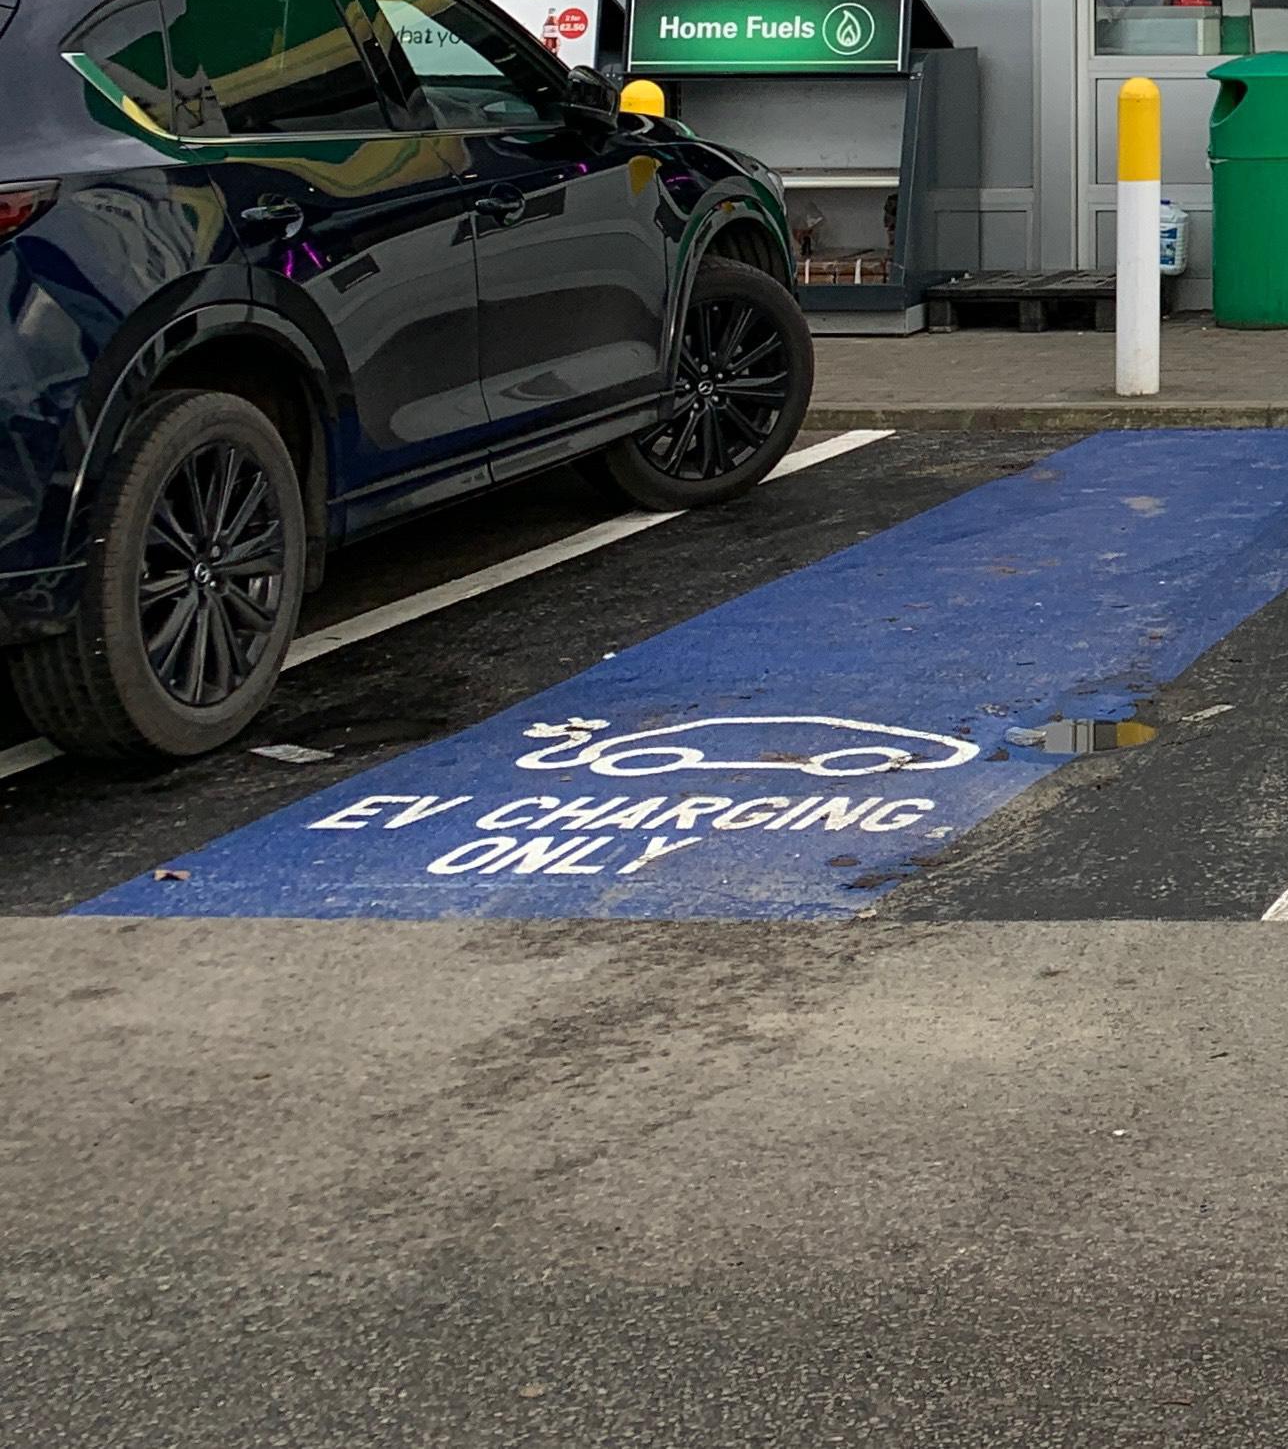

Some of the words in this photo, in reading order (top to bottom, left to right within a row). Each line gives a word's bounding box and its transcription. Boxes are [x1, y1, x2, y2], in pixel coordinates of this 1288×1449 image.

[660, 16, 738, 39] Home
[746, 16, 816, 39] Fuels
[307, 795, 475, 830] EV
[475, 796, 935, 832] CHARGING
[425, 836, 702, 875] ONLY
